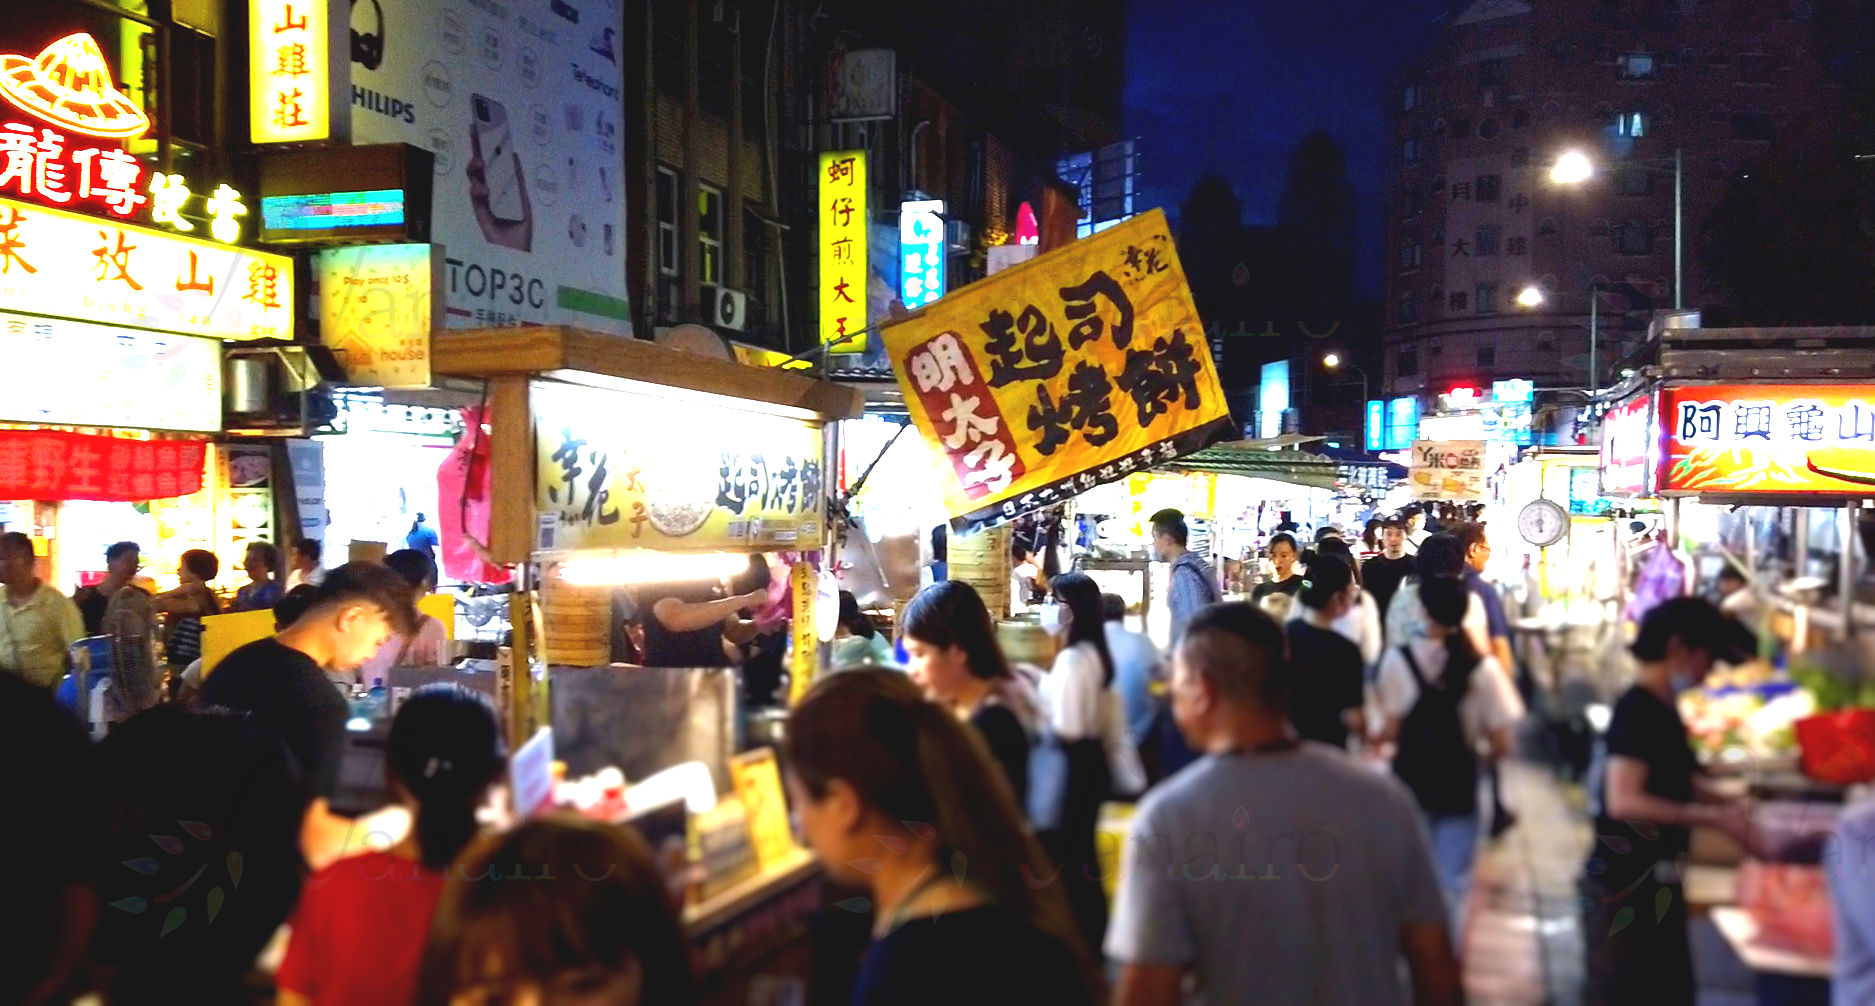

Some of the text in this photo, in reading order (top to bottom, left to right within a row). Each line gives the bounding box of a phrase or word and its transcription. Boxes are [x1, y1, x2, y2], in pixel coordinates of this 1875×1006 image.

[351, 84, 416, 124] HILIPS
[445, 258, 544, 309] TOP3C
[827, 156, 857, 344] 蚵仔煎大王
[380, 345, 425, 362] house
[980, 270, 1134, 389] 起司
[911, 331, 1016, 494] 明太子
[1027, 327, 1201, 456] 烤餅
